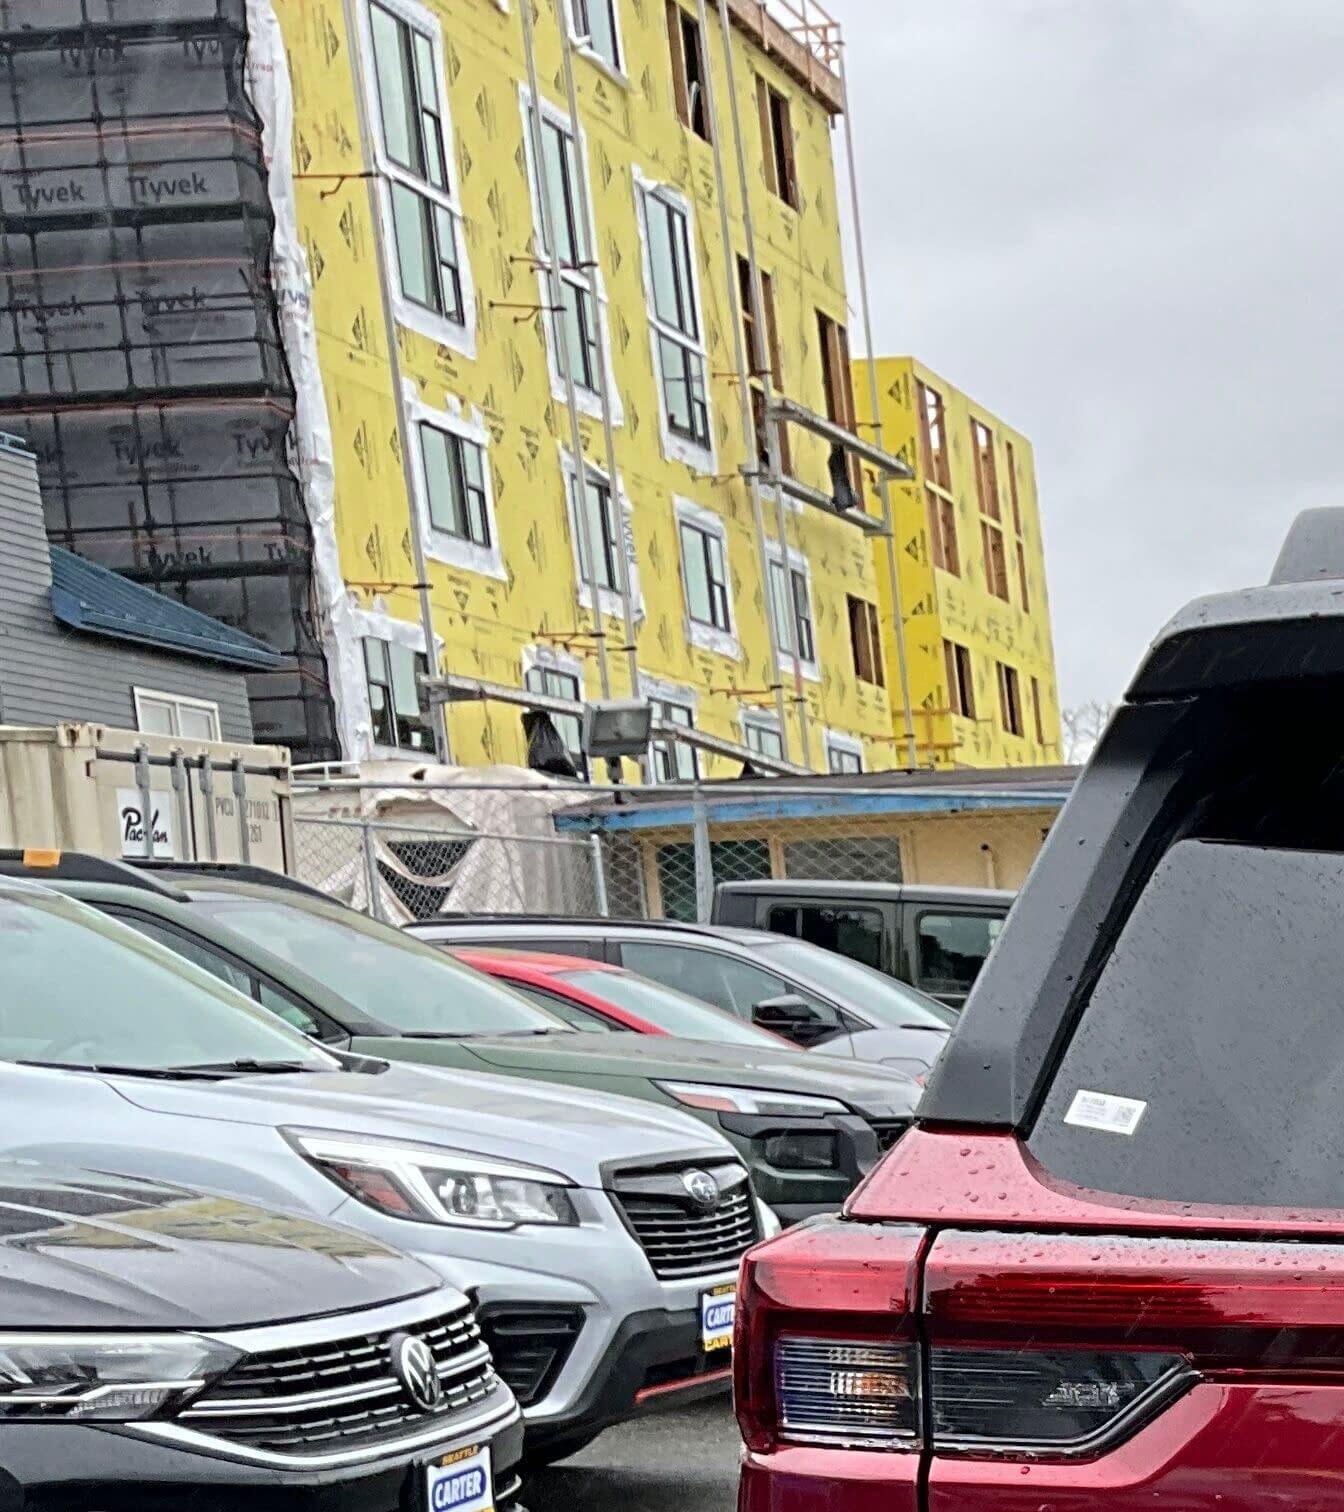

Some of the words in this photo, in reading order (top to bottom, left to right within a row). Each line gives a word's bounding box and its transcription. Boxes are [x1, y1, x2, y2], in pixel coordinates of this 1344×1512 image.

[14, 180, 86, 210] Tyvek
[134, 172, 208, 204] Tyvek
[434, 1469, 483, 1510] CARTER
